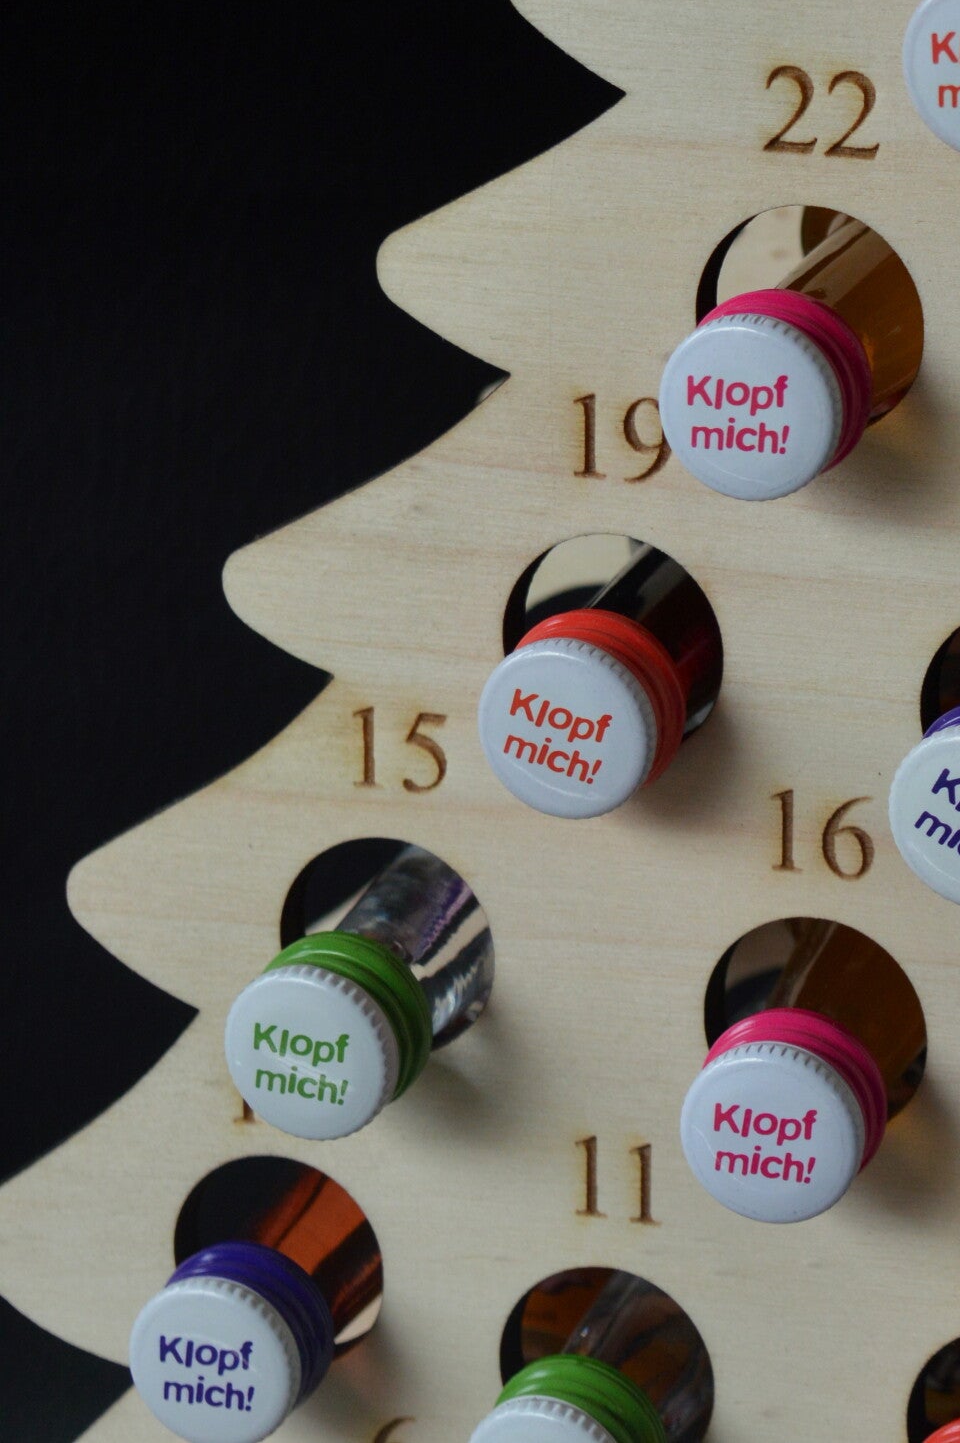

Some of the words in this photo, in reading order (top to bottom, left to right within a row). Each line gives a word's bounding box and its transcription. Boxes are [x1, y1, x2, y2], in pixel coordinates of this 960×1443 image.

[762, 64, 880, 161] 22
[685, 374, 789, 416] Klopf
[572, 393, 671, 482] 19
[690, 419, 791, 455] mich!
[509, 688, 613, 744] Klopf
[352, 706, 449, 793] 15
[503, 737, 602, 785] mich!
[770, 789, 875, 880] 16
[252, 1022, 349, 1067] Klopf
[254, 1065, 349, 1106] mich!
[712, 1102, 818, 1144] Klopf
[574, 1135, 662, 1226] 11
[714, 1146, 816, 1184] mich!
[158, 1334, 254, 1372] Klopf
[162, 1376, 255, 1412] mich!
